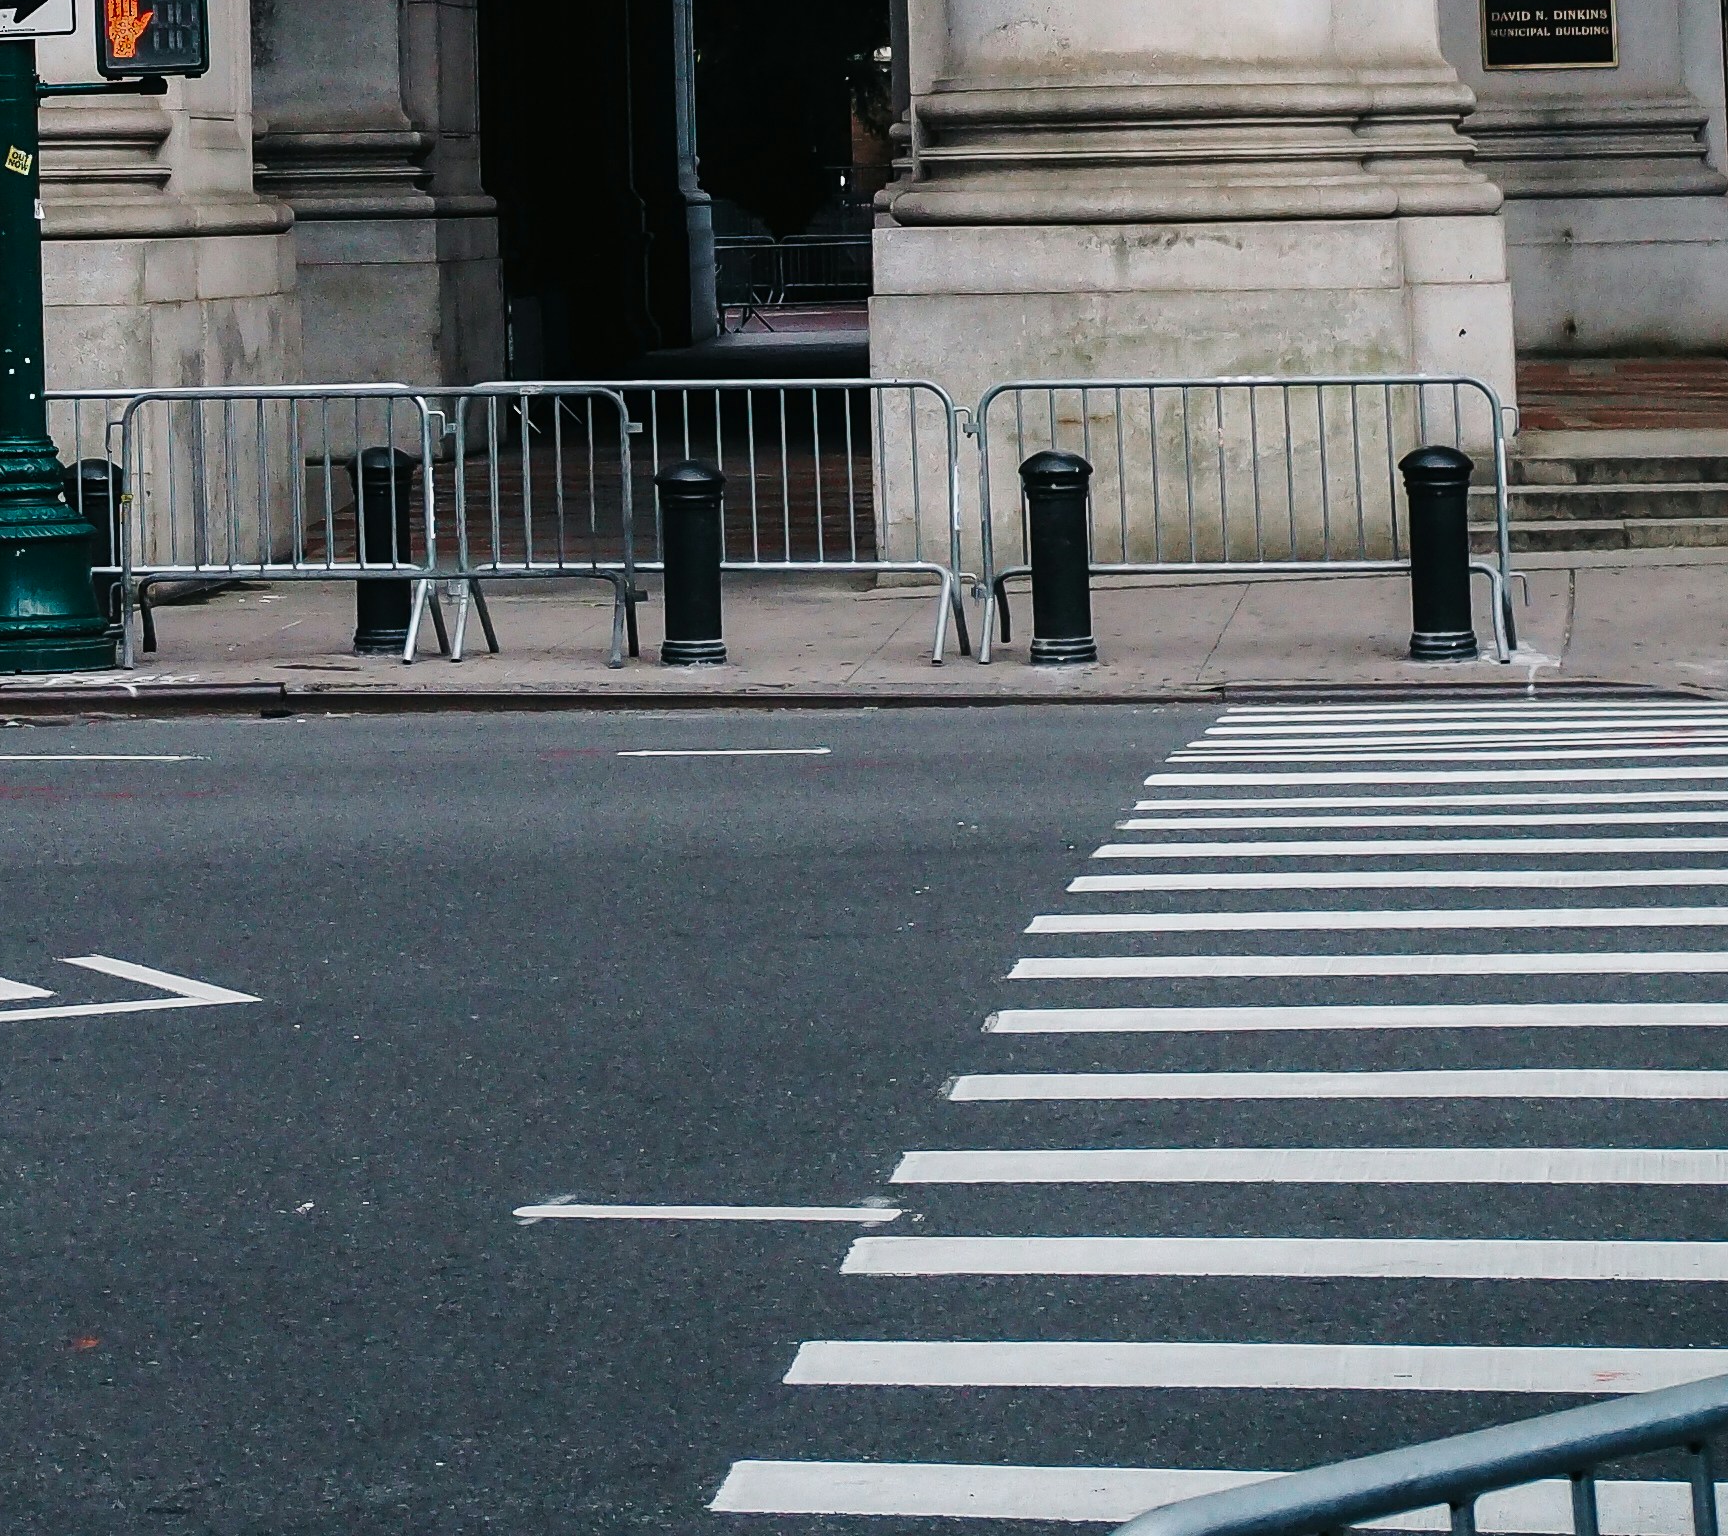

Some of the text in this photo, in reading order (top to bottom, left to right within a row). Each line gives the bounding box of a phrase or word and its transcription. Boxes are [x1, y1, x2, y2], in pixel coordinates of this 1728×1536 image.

[1491, 9, 1608, 22] DAVID N. DINKINS
[1491, 26, 1609, 37] MUNICIPAL BUILDING
[8, 158, 29, 171] NOW
